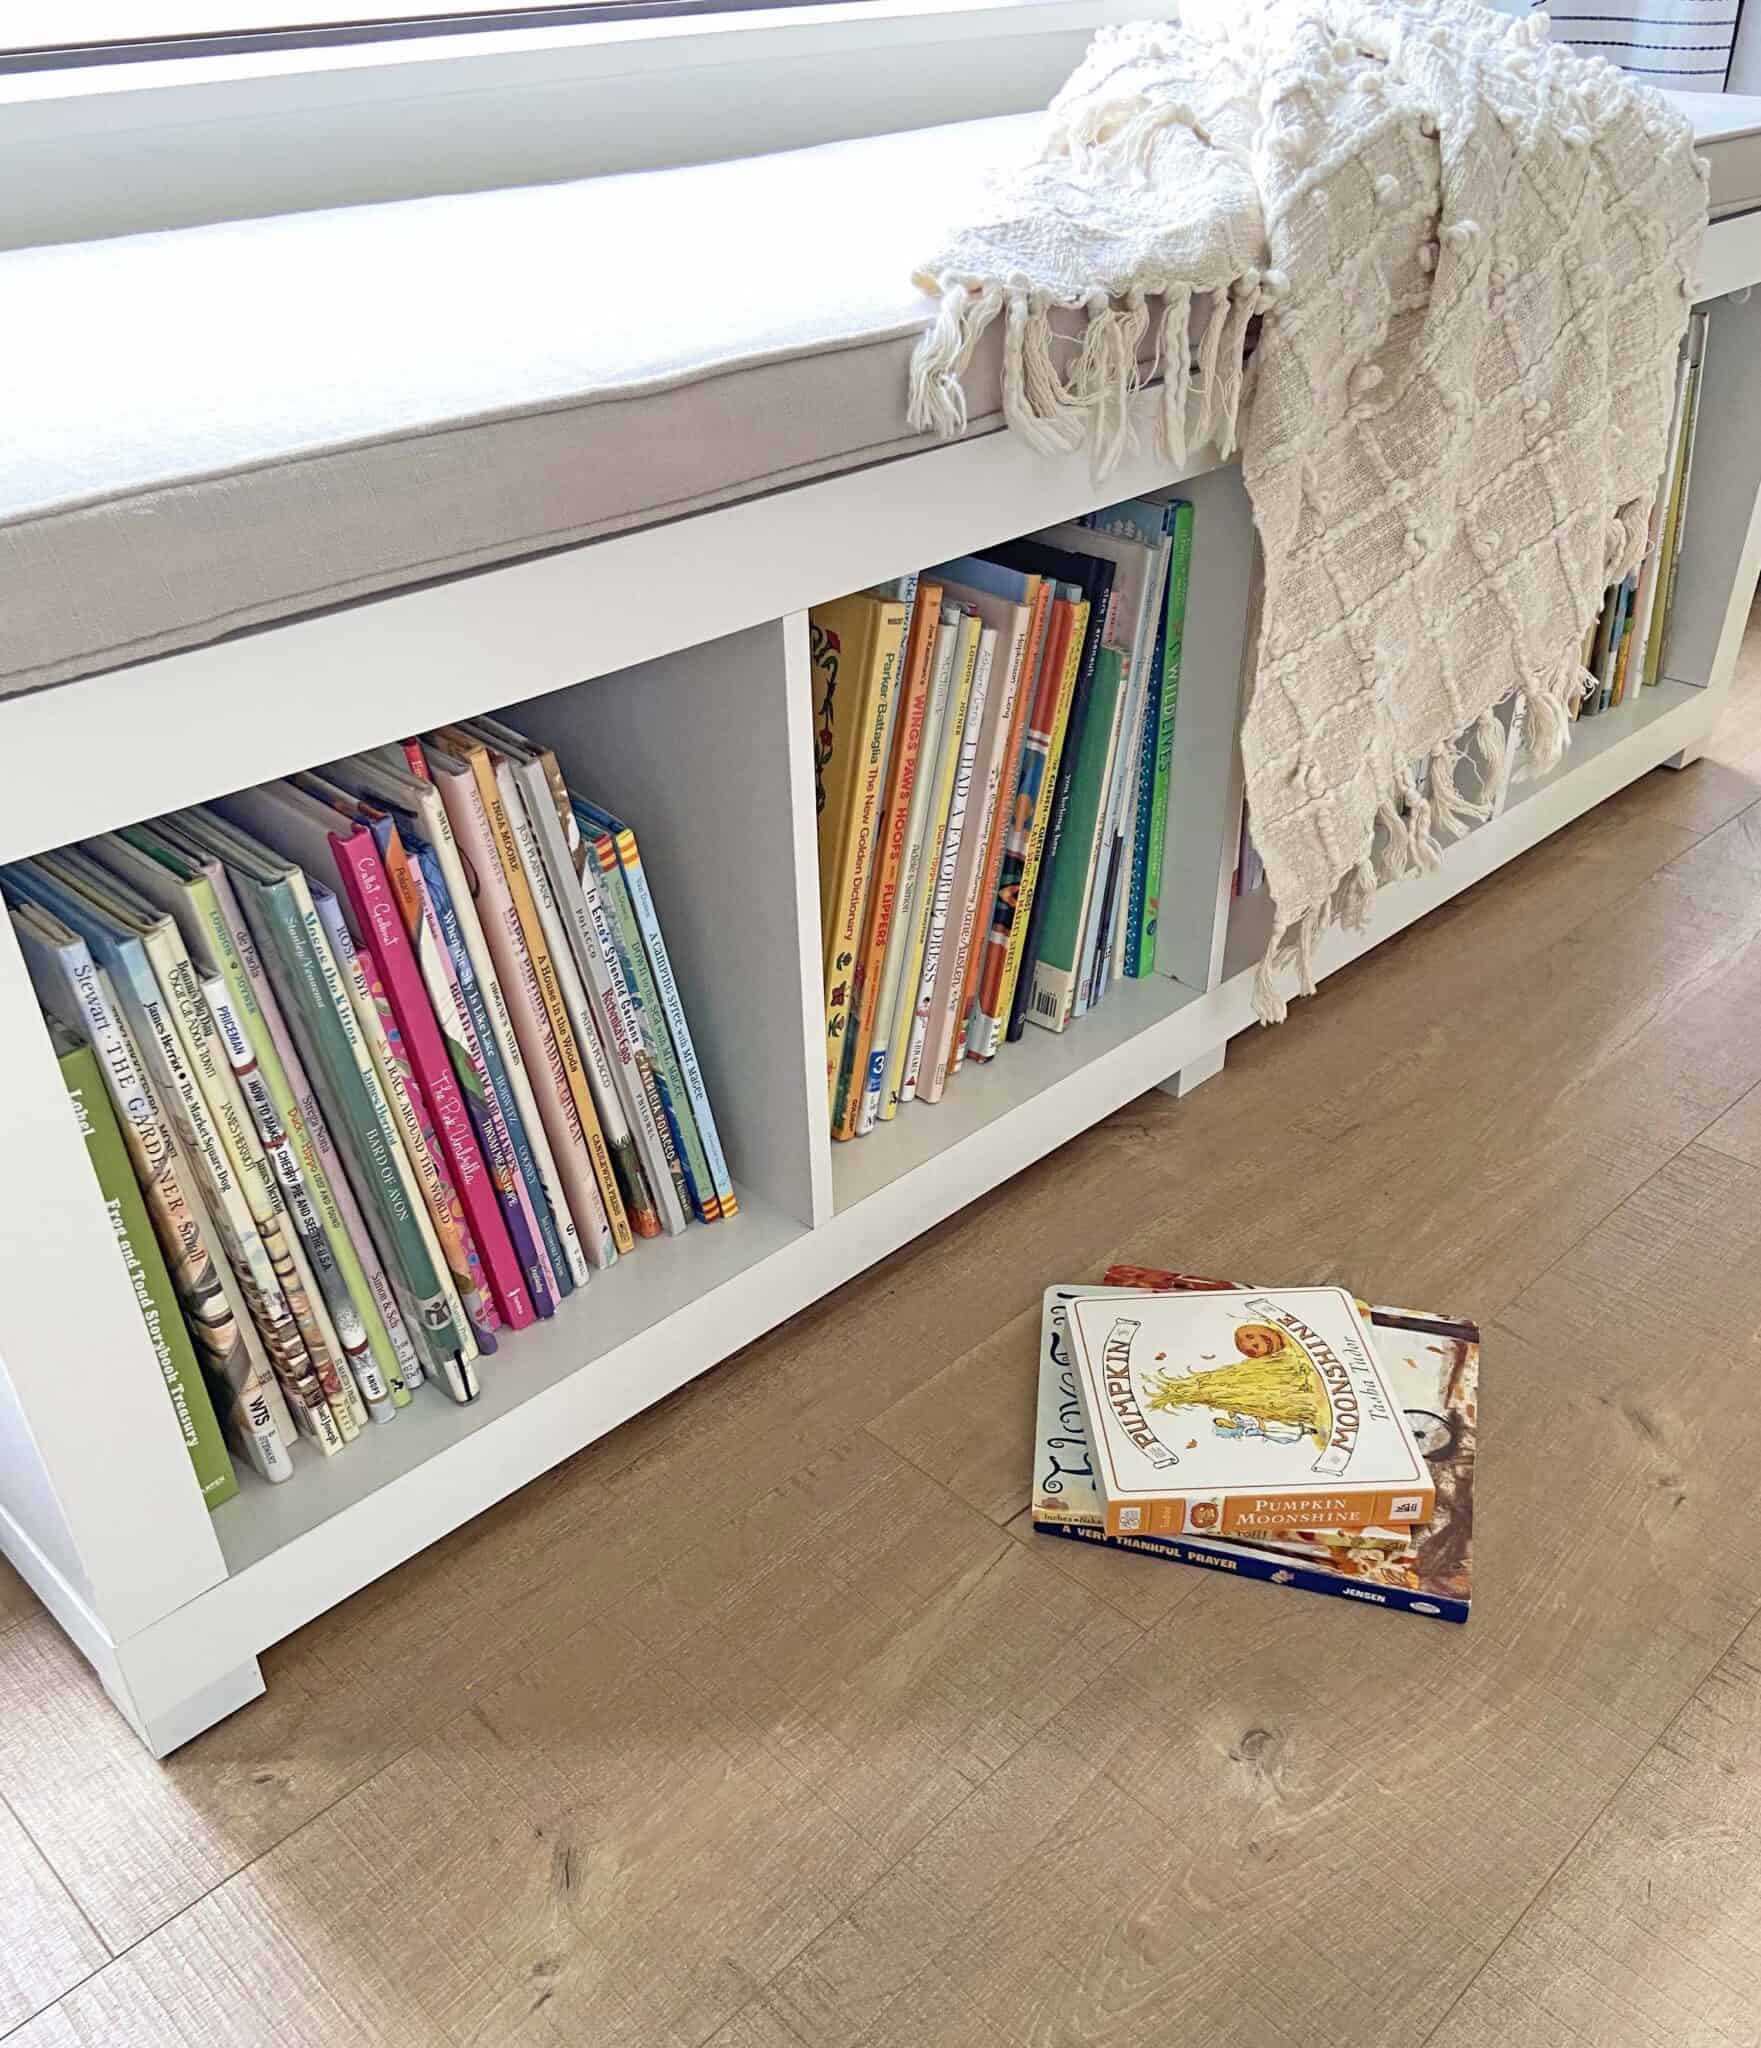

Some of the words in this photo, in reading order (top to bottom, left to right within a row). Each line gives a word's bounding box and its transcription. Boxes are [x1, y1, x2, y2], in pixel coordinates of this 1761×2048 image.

[877, 651, 897, 699] Parker
[1008, 632, 1026, 685] Hopkinson
[866, 701, 889, 765] Battaglia
[904, 693, 927, 752] WINGS
[965, 740, 977, 750] I
[864, 766, 879, 794] The
[898, 756, 917, 801] PAWS
[955, 756, 974, 800] HAD
[434, 809, 453, 843] SMALL
[859, 793, 874, 825] New
[952, 806, 964, 818] A
[490, 798, 507, 831] INGA
[499, 829, 520, 873] MOORE
[515, 822, 533, 850] JUST
[851, 826, 870, 875] Golden
[887, 804, 909, 861] HOOFS
[1028, 823, 1039, 850] LAST
[934, 825, 961, 918] FAVORITE
[585, 888, 599, 903] In
[843, 876, 864, 941] Dictionary
[873, 882, 895, 947] FLIPPERS
[441, 909, 462, 946] When
[573, 907, 600, 960] POLACCO
[590, 905, 613, 944] Enzo's
[960, 904, 976, 938] Jane
[335, 923, 358, 964] ROSE
[536, 953, 548, 965] A
[923, 925, 944, 986] DRESS
[603, 945, 630, 997] Splendid
[950, 937, 970, 989] Austen
[353, 972, 371, 1001] BYE
[538, 964, 561, 1003] House
[144, 999, 168, 1036] James
[471, 1004, 490, 1032] Like
[551, 1001, 564, 1016] in
[554, 1014, 570, 1036] the
[619, 998, 644, 1043] Gardens
[216, 1004, 247, 1057] PRICEMAN
[446, 981, 474, 1033] BREAD
[464, 1033, 483, 1063] AND
[475, 1065, 492, 1090] JAM
[484, 1092, 501, 1116] FOR
[479, 1030, 498, 1058] Lace
[675, 1026, 689, 1048] with
[159, 1034, 183, 1073] Herriot
[382, 1054, 395, 1066] A
[559, 1035, 582, 1073] Woods
[873, 1055, 885, 1074] 3
[909, 1038, 923, 1074] ABRAMS
[180, 1081, 197, 1104] The
[247, 1079, 266, 1104] HOW
[386, 1064, 407, 1100] RACE
[428, 1070, 455, 1102] The
[73, 962, 114, 1031] Stewart
[106, 1041, 136, 1088] THE
[128, 1095, 185, 1212] GARDENER
[175, 1219, 206, 1263] Small
[187, 1101, 211, 1140] Market
[219, 1100, 242, 1133] JAMES
[257, 1103, 271, 1117] TO
[262, 1114, 282, 1143] MAKE
[299, 1095, 323, 1128] Strega
[311, 1124, 334, 1156] Nona
[399, 1101, 426, 1154] AROUND
[439, 1096, 466, 1129] Pink
[200, 1136, 225, 1174] Square
[364, 1127, 389, 1167] BARD
[447, 1124, 484, 1186] Umbrella
[515, 1143, 538, 1186] COONEY
[214, 1170, 232, 1193] Dog
[275, 1149, 298, 1184] CHERRY
[378, 1165, 397, 1187] OF
[418, 1152, 436, 1181] THE
[289, 1183, 305, 1200] PIE
[295, 1198, 312, 1217] AND
[385, 1184, 411, 1223] AVON
[427, 1180, 452, 1225] WORLD
[105, 1196, 131, 1238] Frog
[303, 1215, 319, 1234] SEE
[120, 1239, 141, 1268] and
[309, 1232, 325, 1249] THE
[130, 1269, 154, 1307] Toad
[143, 1308, 180, 1383] Storybook
[1343, 1335, 1369, 1374] Tudor
[1106, 1340, 1160, 1449] PUMPKIN
[1277, 1312, 1360, 1455] MOONSHINE
[1359, 1379, 1390, 1421] Tasha
[168, 1382, 202, 1448] Treasury
[246, 1394, 271, 1427] WTS
[1236, 1511, 1361, 1526] MOONSHINE
[1255, 1499, 1347, 1512] PUMPKIN
[1062, 1524, 1072, 1533] A
[1114, 1533, 1183, 1559] THANKFUL
[1186, 1549, 1239, 1570] PRAYER
[1341, 1585, 1387, 1604] JENSEN
